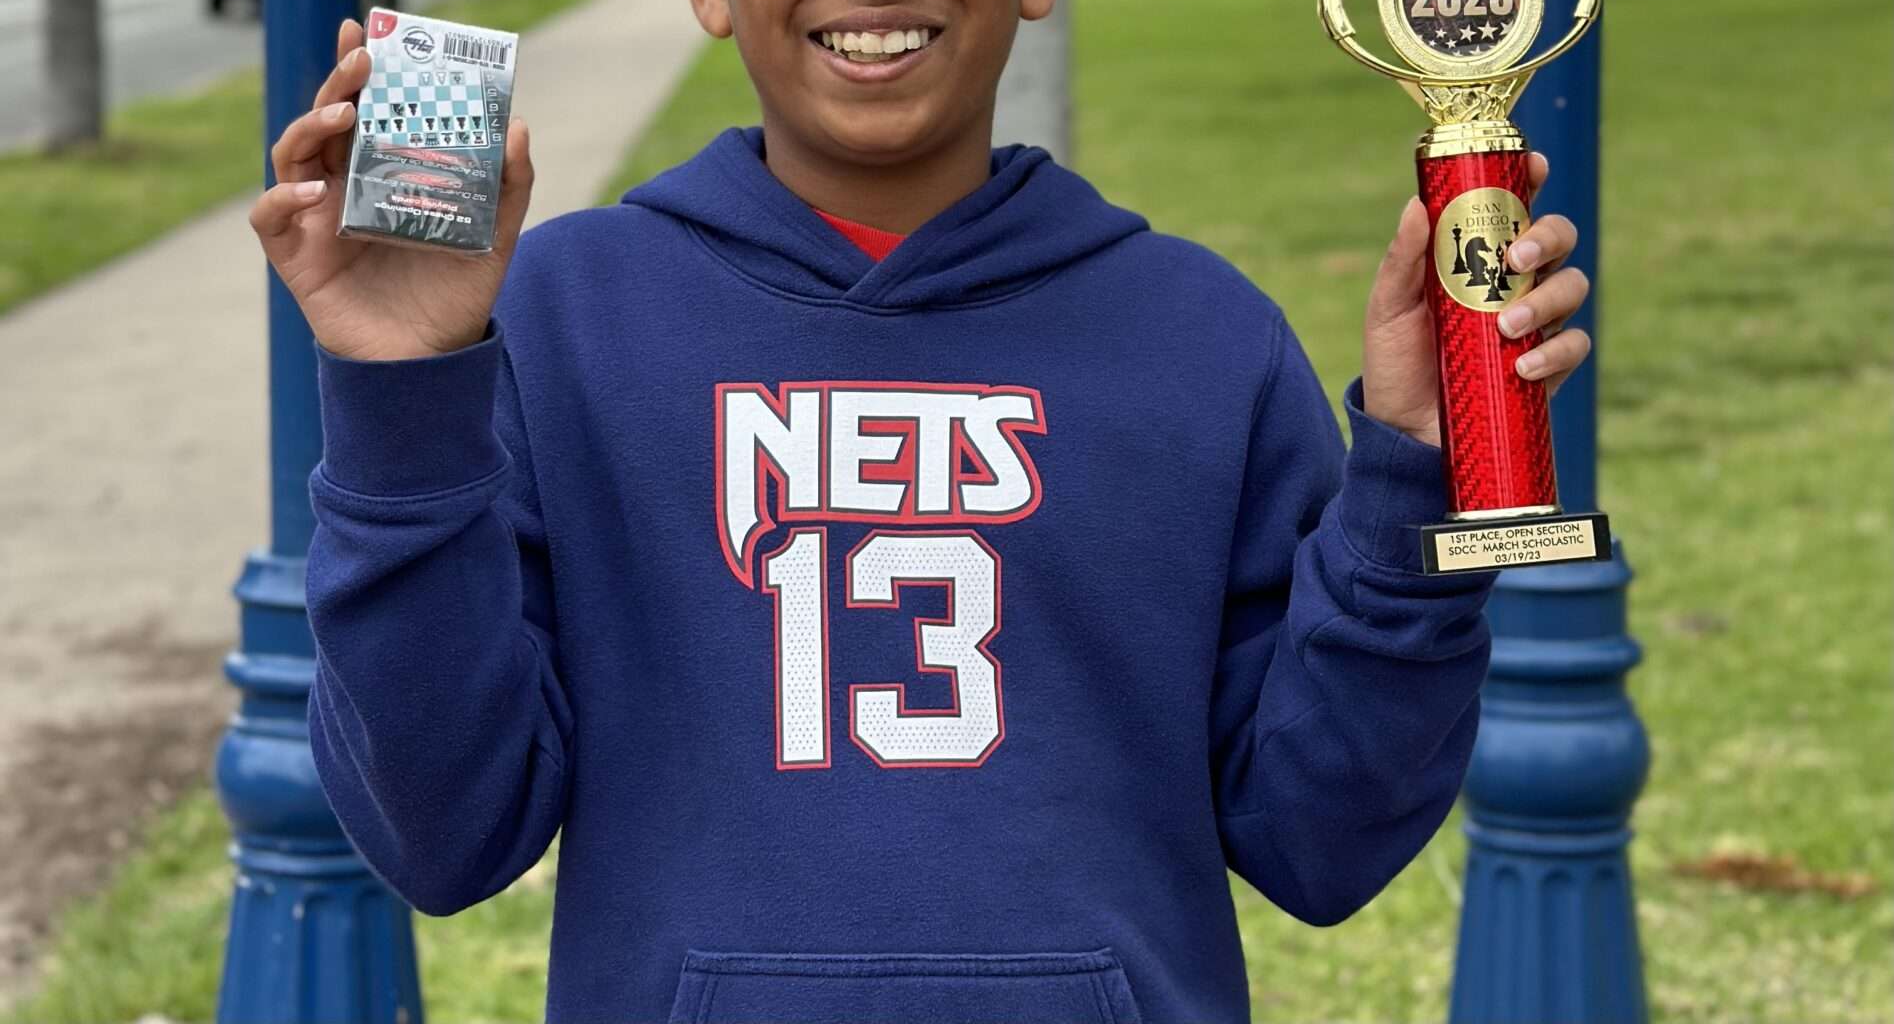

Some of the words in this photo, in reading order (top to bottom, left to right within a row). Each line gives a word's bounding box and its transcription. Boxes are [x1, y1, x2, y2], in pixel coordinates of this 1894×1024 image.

[1471, 202, 1501, 214] SAN
[424, 210, 455, 221] Chess
[456, 215, 472, 224] 52
[1465, 215, 1509, 227] DIEGO
[715, 381, 1048, 590] NETS
[1450, 534, 1467, 544] 1ST
[1469, 530, 1503, 542] PLACE,
[1505, 527, 1534, 538] OPEN
[1537, 523, 1580, 536] SECTION
[1448, 545, 1477, 556] SDCC
[1482, 540, 1520, 553] MARCH
[1522, 534, 1584, 549] SCHOLASTIC
[1495, 550, 1541, 564] 03/19/23
[761, 526, 1006, 770] 13
